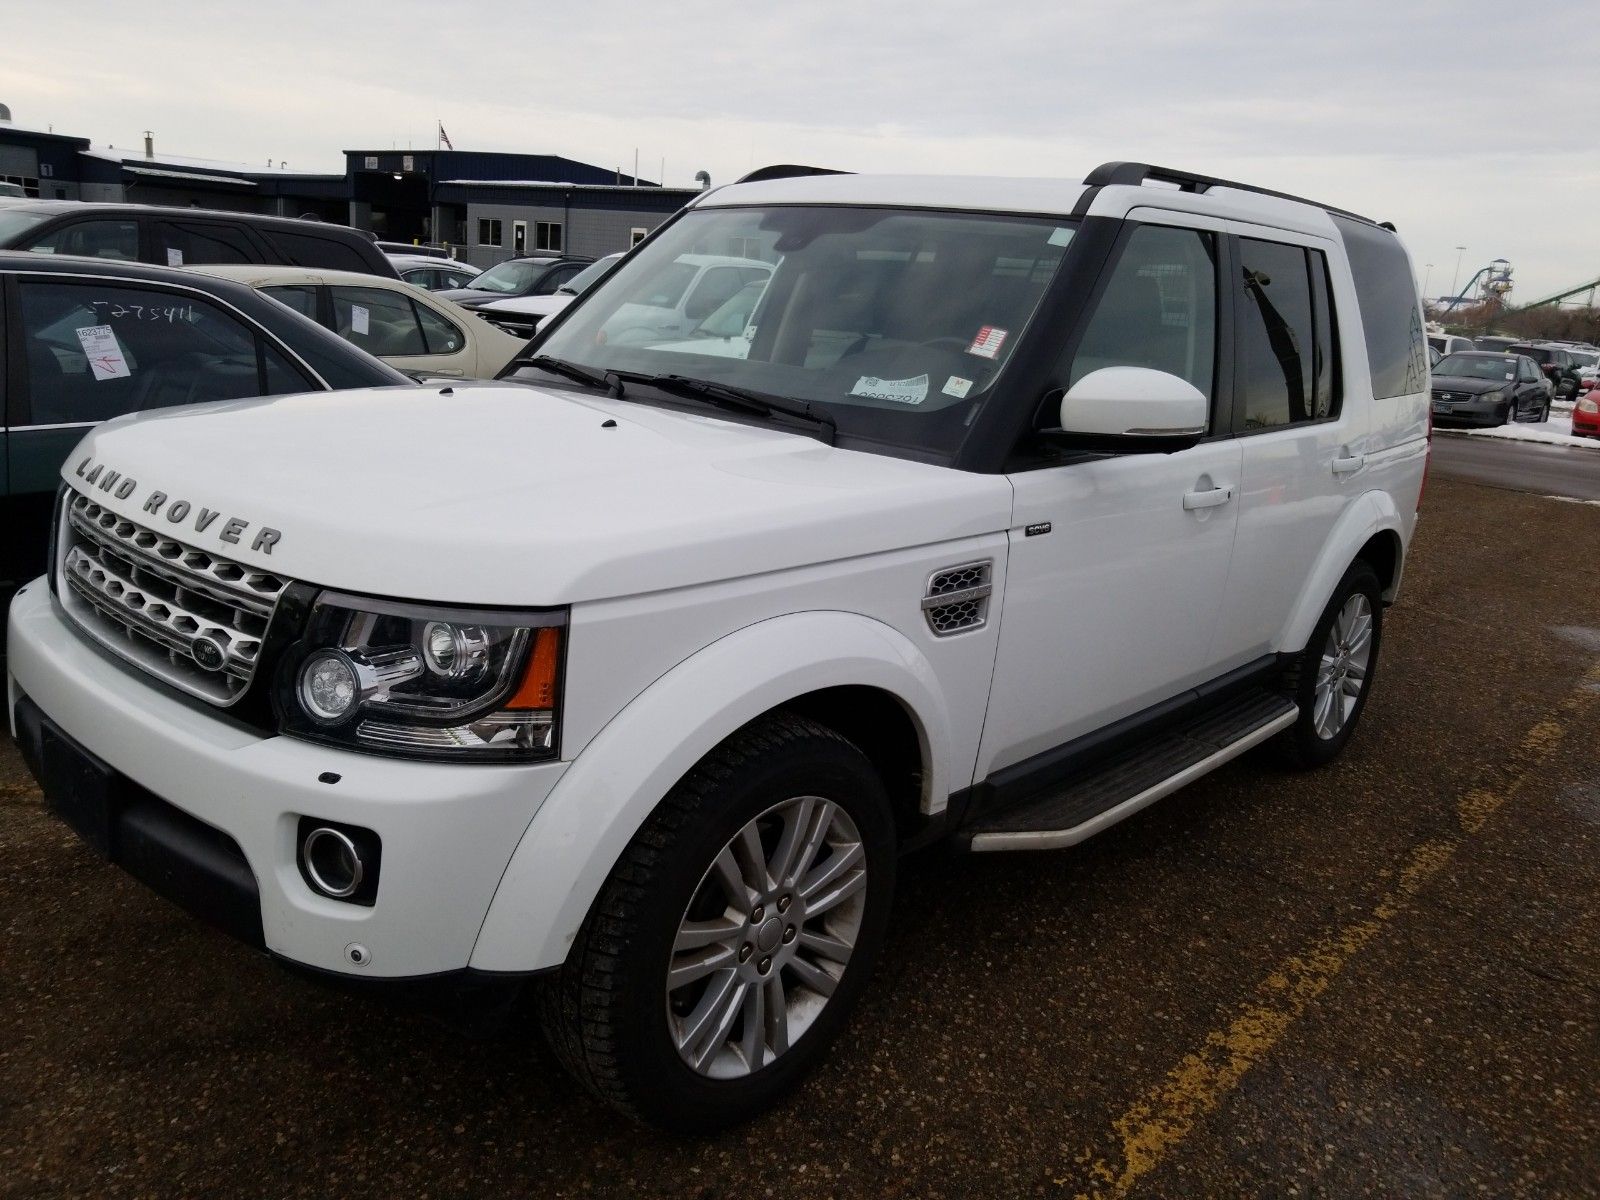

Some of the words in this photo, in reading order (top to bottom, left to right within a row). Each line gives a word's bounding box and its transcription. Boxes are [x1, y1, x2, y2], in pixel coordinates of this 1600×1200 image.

[77, 325, 112, 337] 1623775
[76, 457, 137, 500] LAND
[143, 491, 282, 555] ROVER
